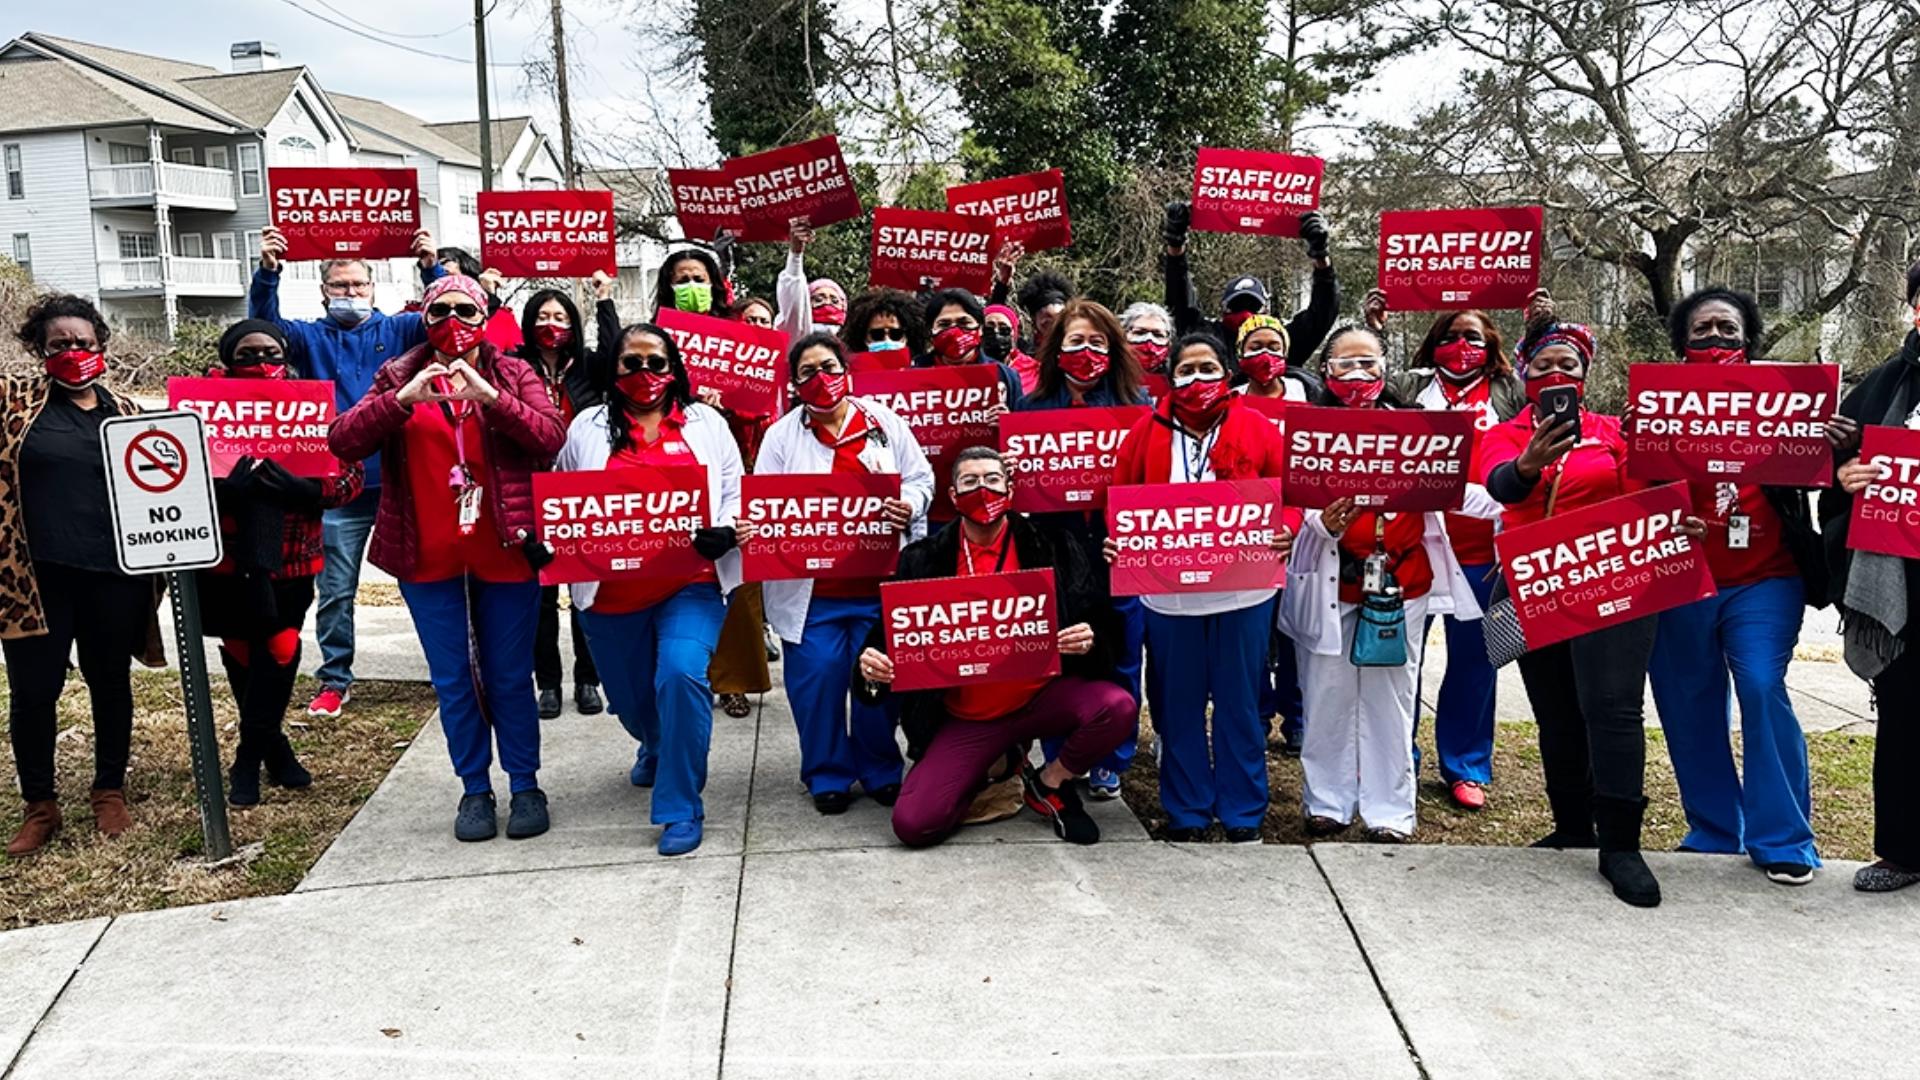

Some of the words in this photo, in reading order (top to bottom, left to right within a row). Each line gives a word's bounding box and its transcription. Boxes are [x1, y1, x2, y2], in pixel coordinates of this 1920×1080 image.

[735, 167, 797, 195] STAFF
[799, 155, 838, 180] UP!
[1200, 167, 1272, 187] STAFF
[1274, 172, 1315, 191] UP!
[277, 189, 362, 207] STAFF
[364, 189, 411, 207] UP!
[740, 196, 767, 209] FOR
[767, 187, 804, 204] SAFE
[806, 175, 845, 194] CARE
[1020, 188, 1058, 208] UP!
[1198, 186, 1228, 198] FOR
[1232, 188, 1270, 201] SAFE
[1273, 192, 1313, 205] CARE
[278, 211, 314, 223] FOR
[318, 211, 362, 222] SAFE
[367, 210, 413, 222] CARE
[680, 203, 705, 213] FOR
[708, 204, 741, 214] SAFE
[995, 212, 1022, 227] AFE
[1024, 206, 1061, 222] CARE
[1196, 200, 1218, 210] End
[1222, 201, 1252, 212] Crisis
[1255, 203, 1281, 215] Care
[1284, 207, 1301, 216] No
[484, 210, 560, 228] STAFF
[563, 210, 607, 228] UP!
[309, 226, 344, 237] Crisis
[350, 226, 380, 236] Care
[384, 226, 413, 235] Now
[485, 232, 517, 243] FOR
[521, 232, 562, 242] SAFE
[566, 231, 608, 242] CARE
[879, 226, 949, 246] STAFF
[950, 232, 989, 249] UP!
[486, 246, 509, 256] End
[513, 246, 546, 256] Crisis
[549, 246, 577, 256] Care
[581, 246, 608, 256] Now
[1387, 232, 1477, 255] STAFF
[1479, 231, 1533, 252] UP!
[878, 246, 907, 258] FOR
[910, 249, 946, 261] SAFE
[950, 251, 988, 264] CARE
[1385, 257, 1423, 271] FOR
[1427, 256, 1475, 270] SAFE
[1481, 255, 1531, 269] CARE
[1385, 275, 1412, 287] End
[1417, 274, 1454, 286] Crisis
[1459, 274, 1492, 285] Care
[1497, 273, 1530, 284] Now
[735, 342, 780, 366] UP!
[690, 354, 730, 372] SAFE
[733, 363, 776, 381] CARE
[714, 374, 740, 388] Care
[744, 380, 771, 393] Now
[945, 387, 991, 408] UP!
[1637, 390, 1752, 416] STAFF
[1756, 392, 1827, 418] UP!
[275, 401, 328, 421] UP!
[224, 424, 273, 438] SAFE
[277, 424, 329, 438] CARE
[1636, 419, 1684, 436] FOR
[1689, 421, 1750, 437] SAFE
[1757, 422, 1824, 438] CARE
[213, 441, 251, 453] Crisis
[257, 441, 292, 453] Care
[1007, 431, 1094, 455] STAFF
[1291, 431, 1398, 456] STAFF
[1401, 435, 1464, 457] UP!
[1635, 438, 1669, 452] End
[1675, 439, 1723, 454] Crisis
[1729, 441, 1772, 455] Care
[1778, 442, 1822, 456] Now
[1019, 458, 1044, 472] OR
[1049, 455, 1095, 470] SAFE
[1290, 456, 1333, 471] FOR
[1339, 459, 1394, 473] SAFE
[1401, 460, 1460, 474] CARE
[1019, 476, 1035, 488] nd
[1040, 475, 1076, 486] Crisis
[1290, 473, 1321, 486] End
[1325, 475, 1369, 489] Crisis
[1375, 476, 1413, 490] Care
[1419, 478, 1457, 489] Now
[543, 493, 642, 520] STAFF
[645, 489, 701, 514] UP!
[1864, 484, 1917, 506] FOR
[149, 506, 181, 524] NO
[748, 497, 839, 520] STAFF
[1116, 506, 1213, 533] STAFF
[1216, 503, 1274, 527] UP!
[1861, 504, 1899, 522] End
[127, 526, 210, 546] SMOKING
[544, 523, 586, 539] FOR
[592, 520, 644, 536] SAFE
[790, 522, 838, 536] SAFE
[843, 521, 892, 535] CARE
[555, 543, 575, 555] nd
[581, 541, 623, 554] Crisis
[628, 538, 664, 550] Care
[668, 537, 690, 547] No
[748, 543, 775, 555] End
[780, 540, 817, 552] Crisis
[822, 539, 855, 551] Care
[860, 539, 891, 550] Now
[1116, 536, 1157, 551] FOR
[1162, 533, 1214, 549] SAFE
[1219, 530, 1275, 546] CARE
[1511, 529, 1617, 581] STAFF
[1621, 509, 1682, 547] UP!
[1117, 555, 1147, 568] End
[1152, 553, 1192, 566] Crisis
[1198, 552, 1234, 565] Care
[1239, 550, 1275, 562] Now
[1518, 575, 1564, 601] FOR
[1568, 556, 1625, 586] SAFE
[1630, 536, 1691, 566] CARE
[1524, 600, 1557, 619] End
[1562, 585, 1607, 607] Crisis
[1611, 573, 1651, 592] Care
[1655, 558, 1695, 579] Now
[891, 600, 988, 629] STAFF
[992, 594, 1047, 620] UP!
[893, 632, 934, 648] FOR
[939, 626, 990, 643] SAFE
[995, 620, 1049, 638] CARE
[895, 651, 924, 664] End
[930, 648, 970, 661] Crisis
[975, 644, 1010, 657] Care
[1015, 640, 1049, 651] Now
